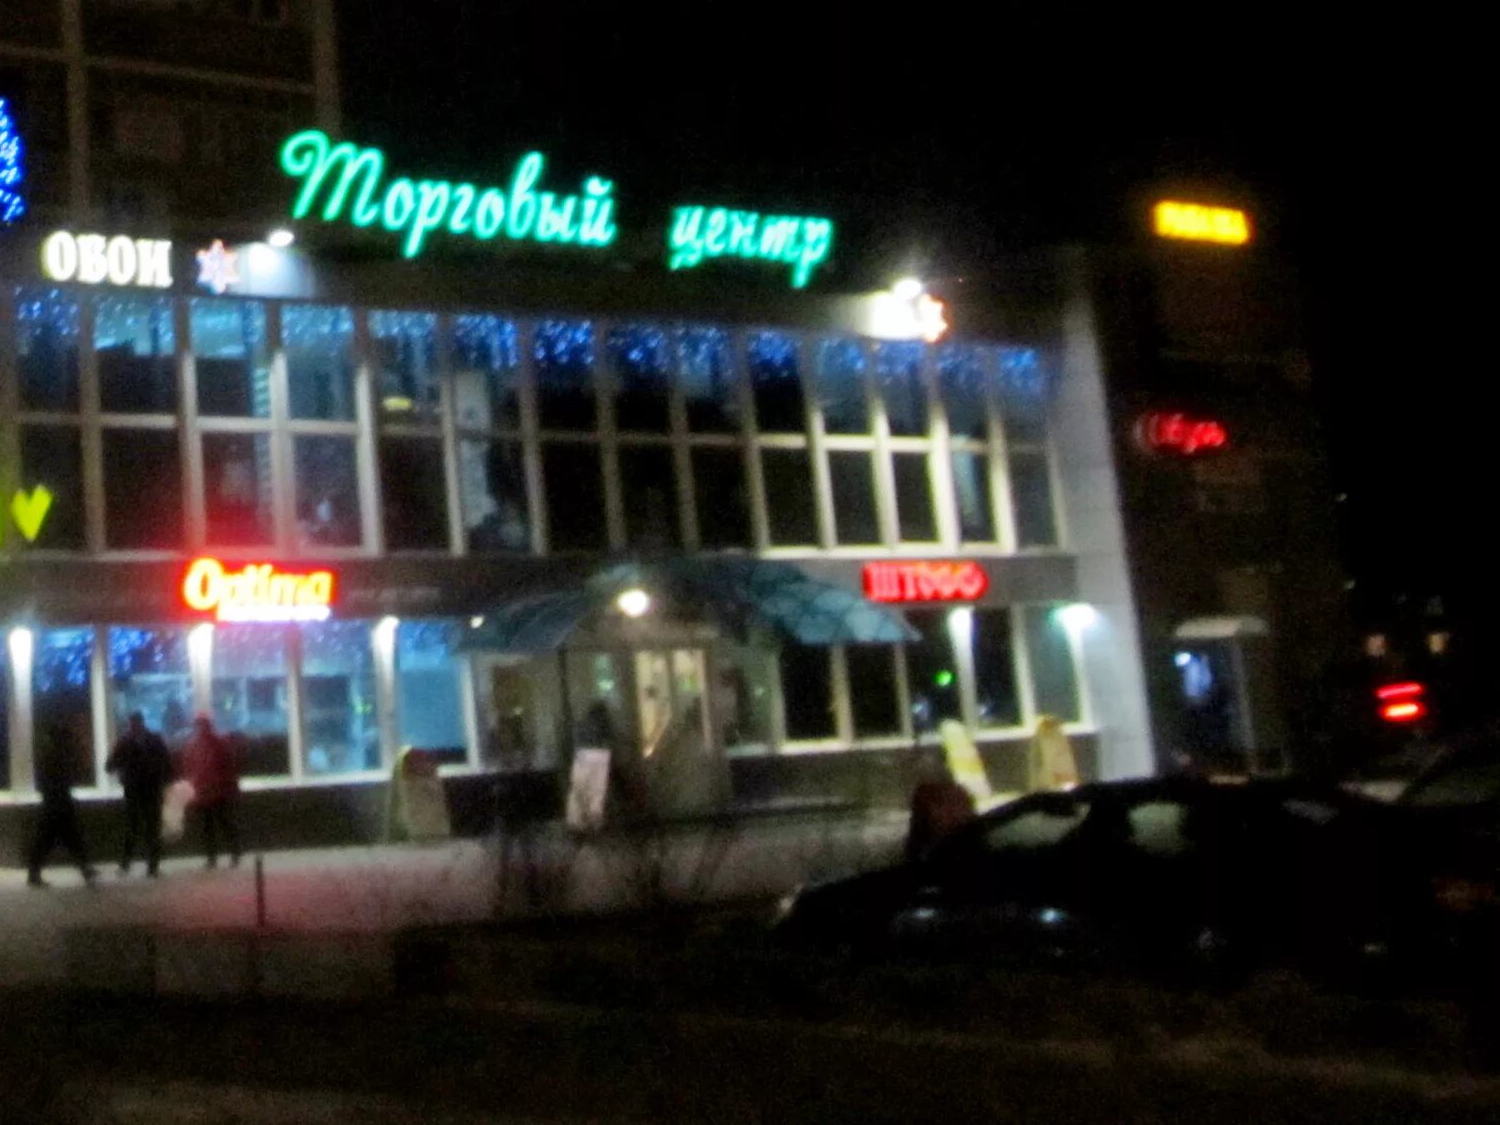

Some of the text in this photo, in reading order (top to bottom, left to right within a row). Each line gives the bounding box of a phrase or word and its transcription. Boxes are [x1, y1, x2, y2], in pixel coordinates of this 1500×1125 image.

[281, 130, 832, 288] Торговый центр
[43, 230, 173, 288] ОБОИ
[184, 557, 333, 615] Optima
